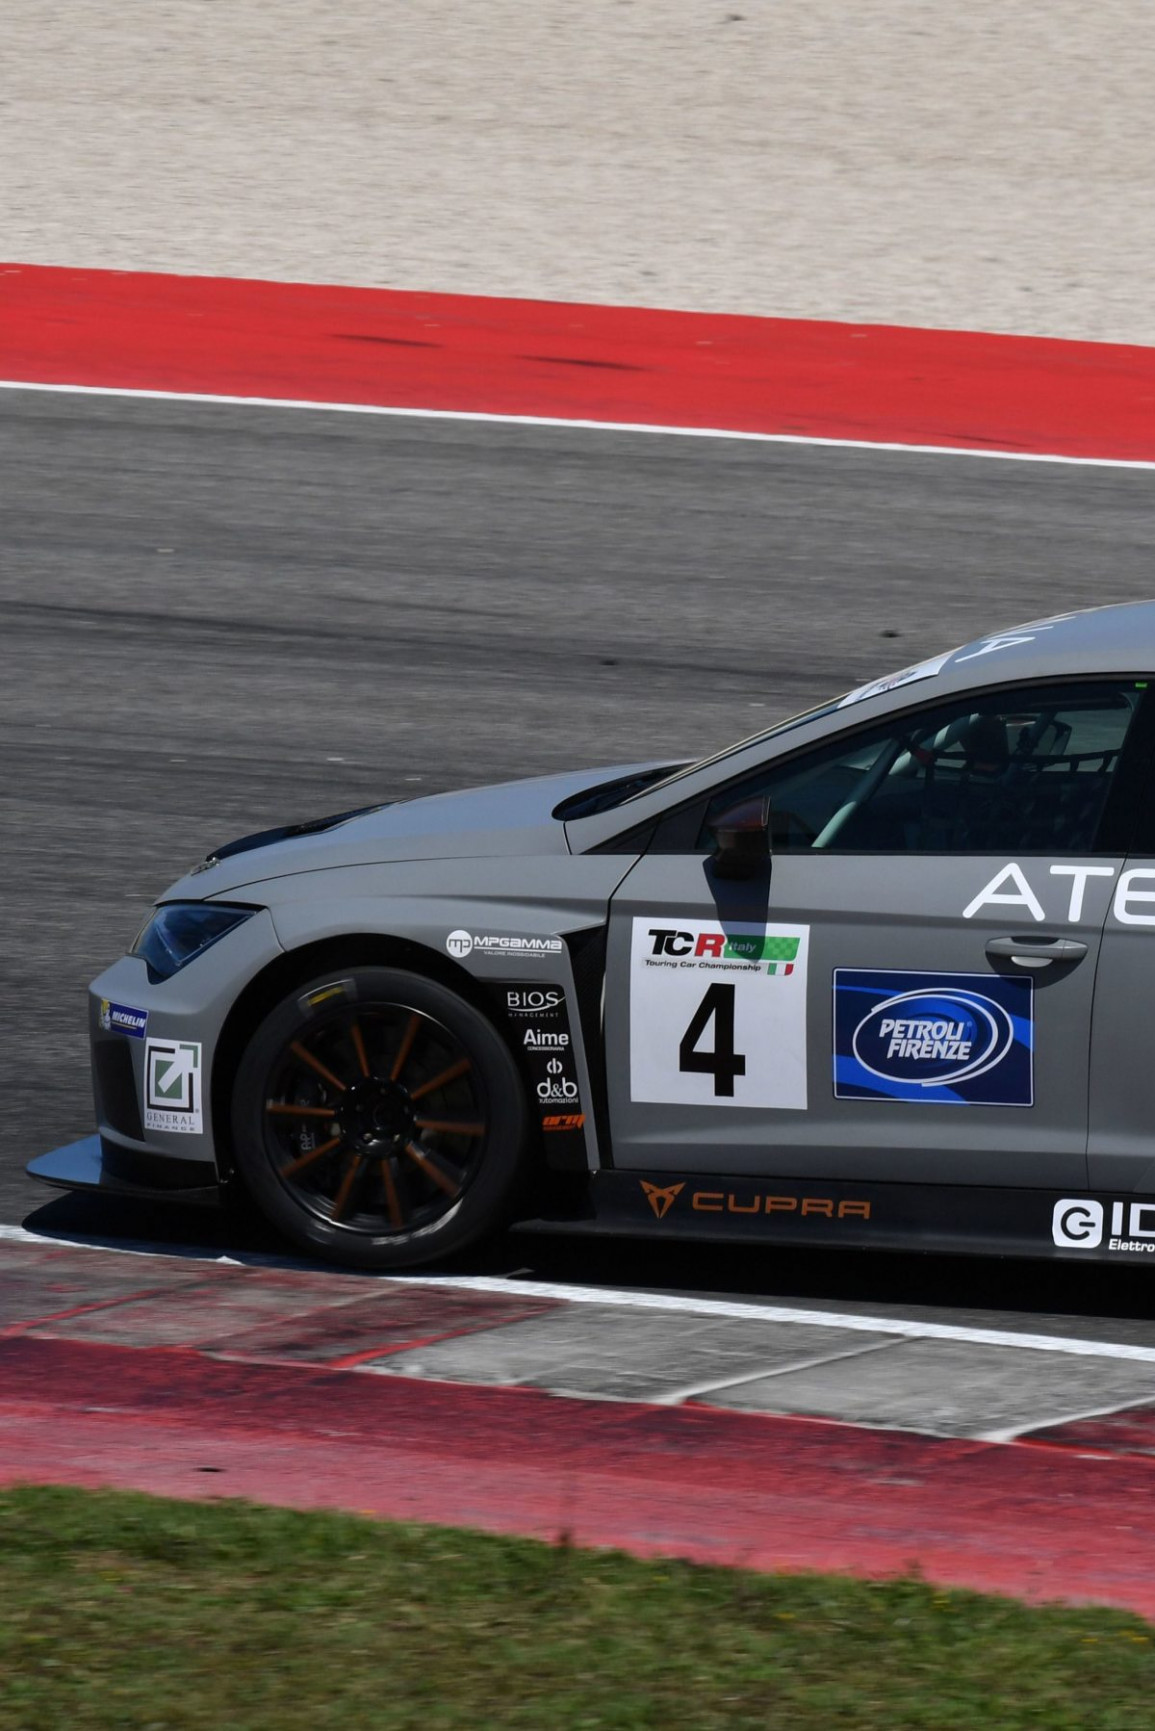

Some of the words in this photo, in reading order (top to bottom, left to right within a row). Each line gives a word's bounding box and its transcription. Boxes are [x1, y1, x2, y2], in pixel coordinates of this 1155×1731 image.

[648, 929, 725, 958] TCR
[645, 959, 678, 969] Touring
[698, 962, 762, 972] Championship
[506, 991, 560, 1007] BIOS
[111, 1011, 146, 1028] MICHELIN
[879, 1019, 965, 1041] PETROLI
[523, 1029, 569, 1046] Aime
[679, 982, 746, 1097] 4
[887, 1038, 972, 1060] FIRENZE
[537, 1077, 578, 1098] d&b
[146, 1110, 195, 1126] GENERAL
[692, 1191, 871, 1220] CUPRA
